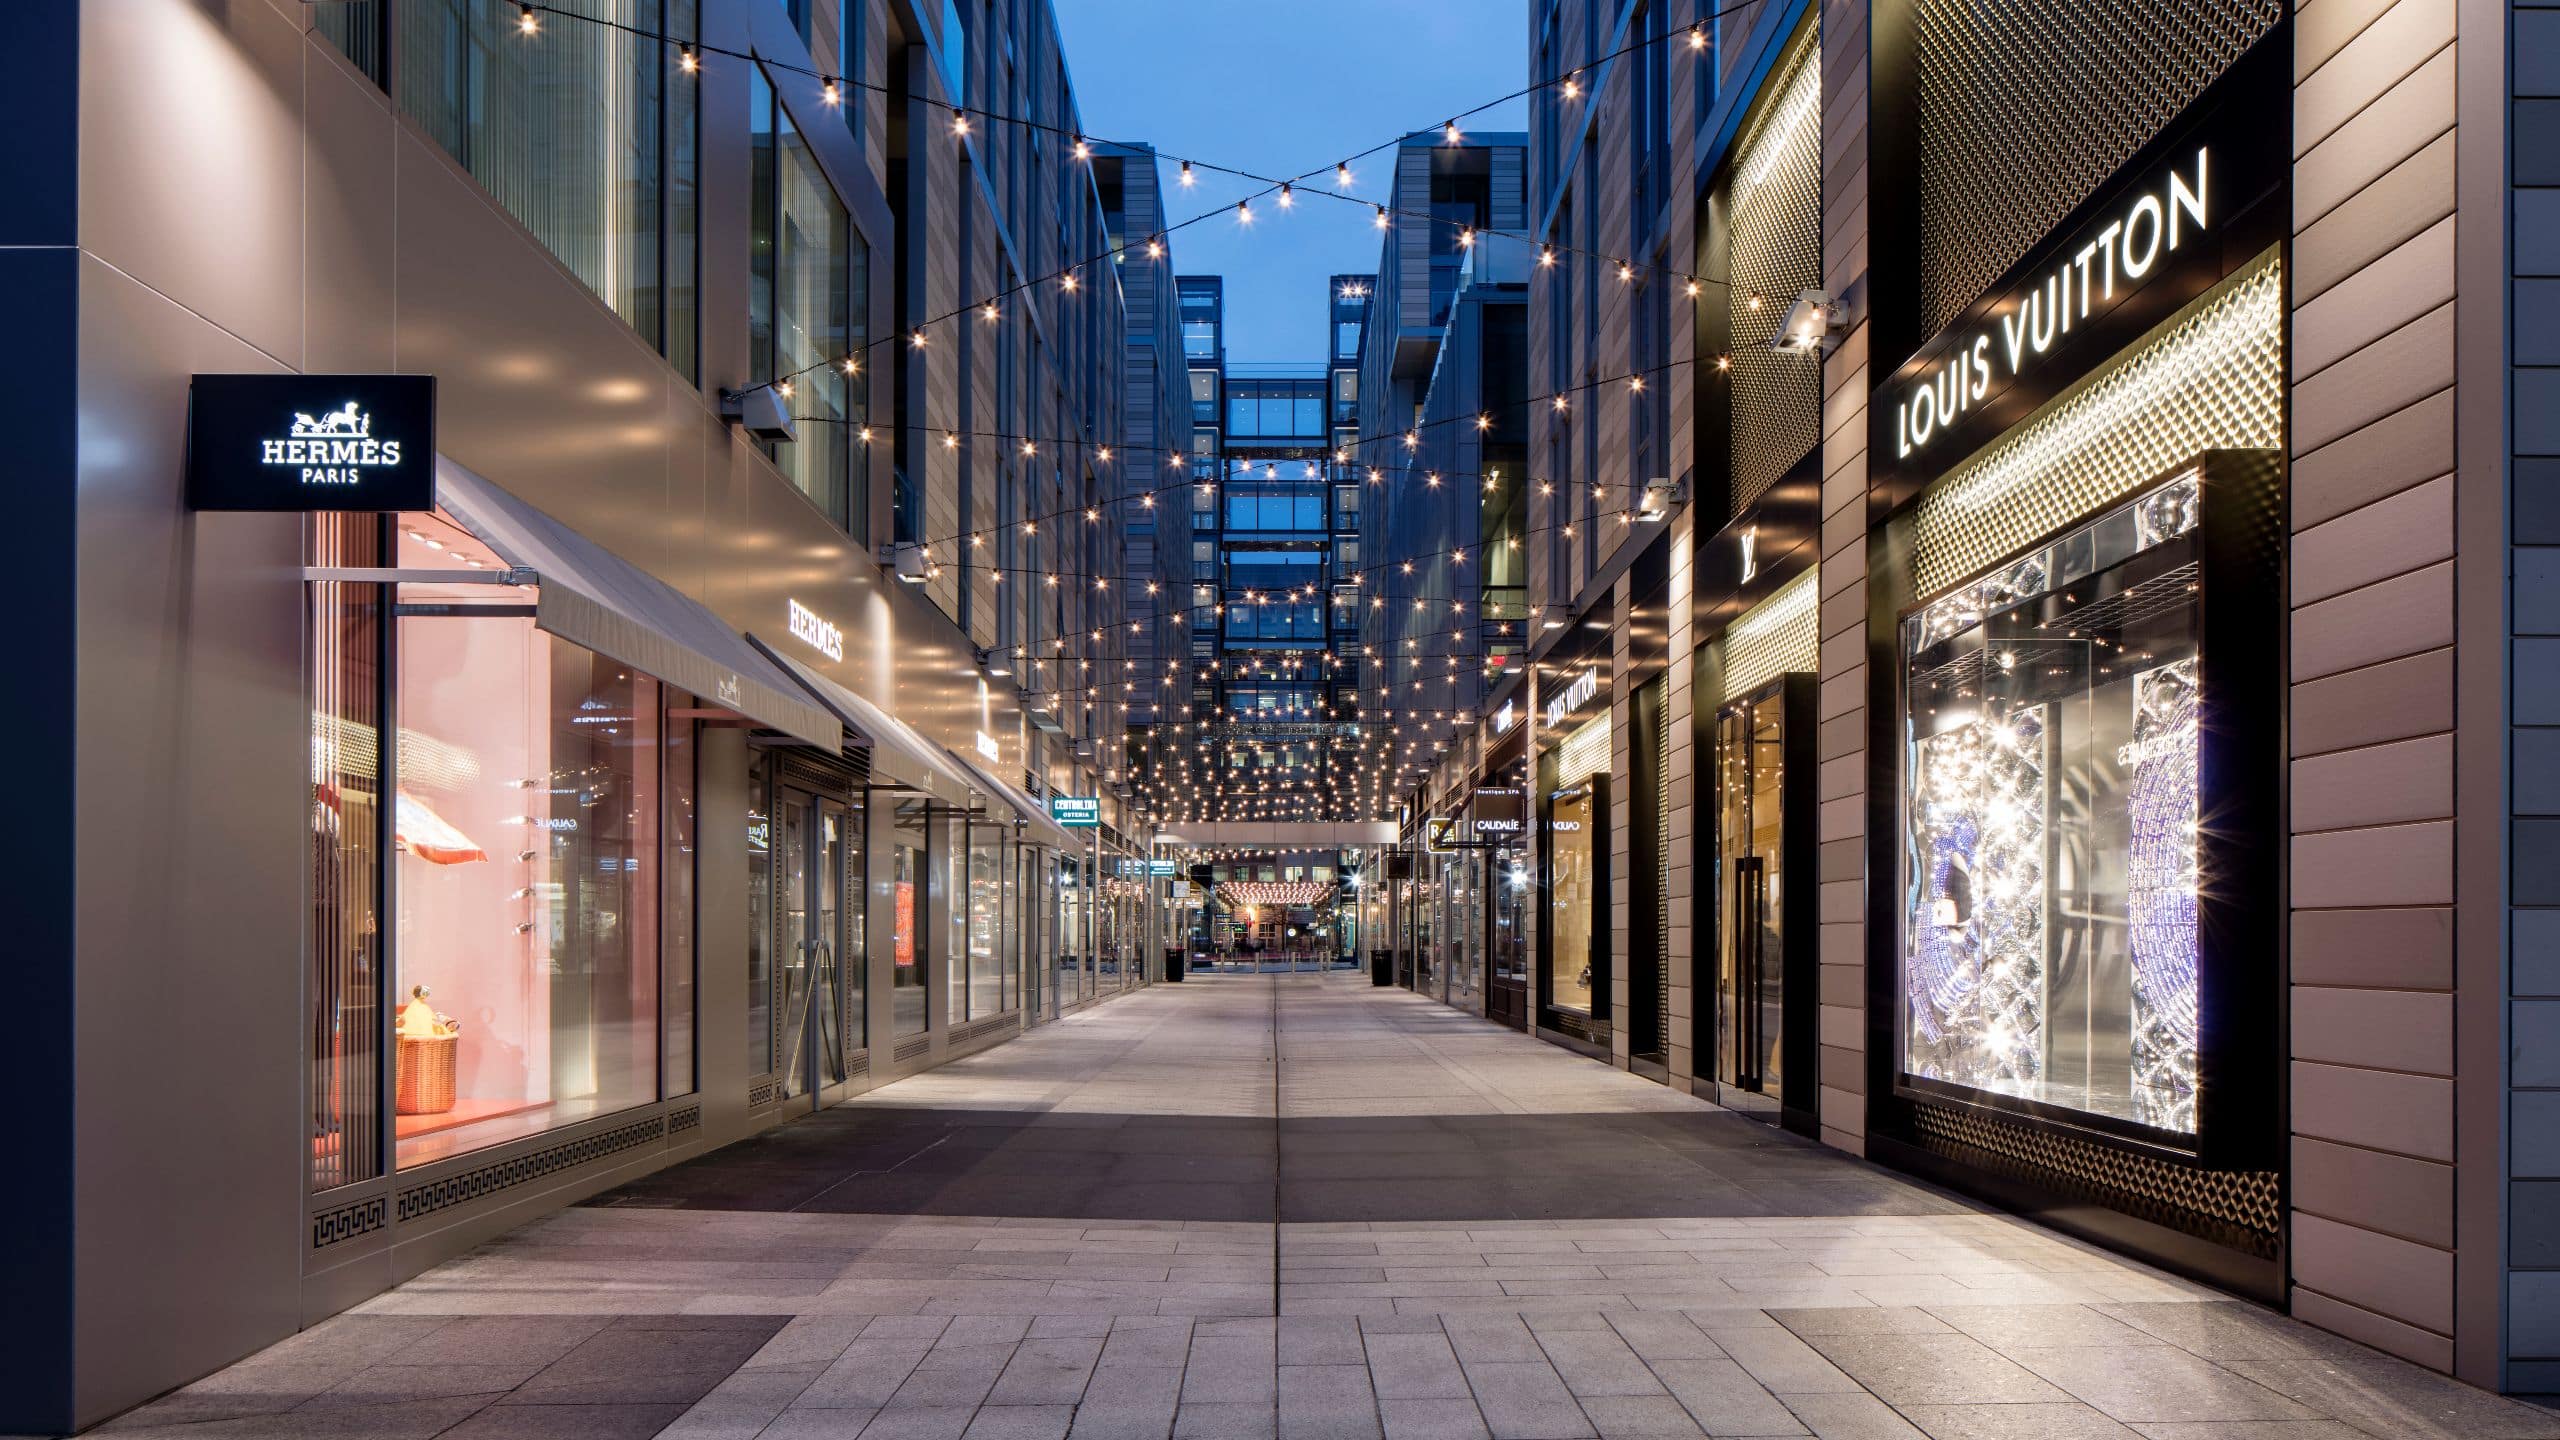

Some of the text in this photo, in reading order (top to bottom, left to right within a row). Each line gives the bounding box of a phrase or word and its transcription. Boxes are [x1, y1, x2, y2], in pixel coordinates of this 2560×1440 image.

[1899, 146, 2208, 459] LOUIS VUITTON
[262, 438, 401, 465] HERMÈS
[302, 468, 359, 484] PARIS
[789, 598, 843, 663] HERMÈS
[1547, 692, 1566, 729] LOUIS
[1566, 666, 1597, 715] VUITTON
